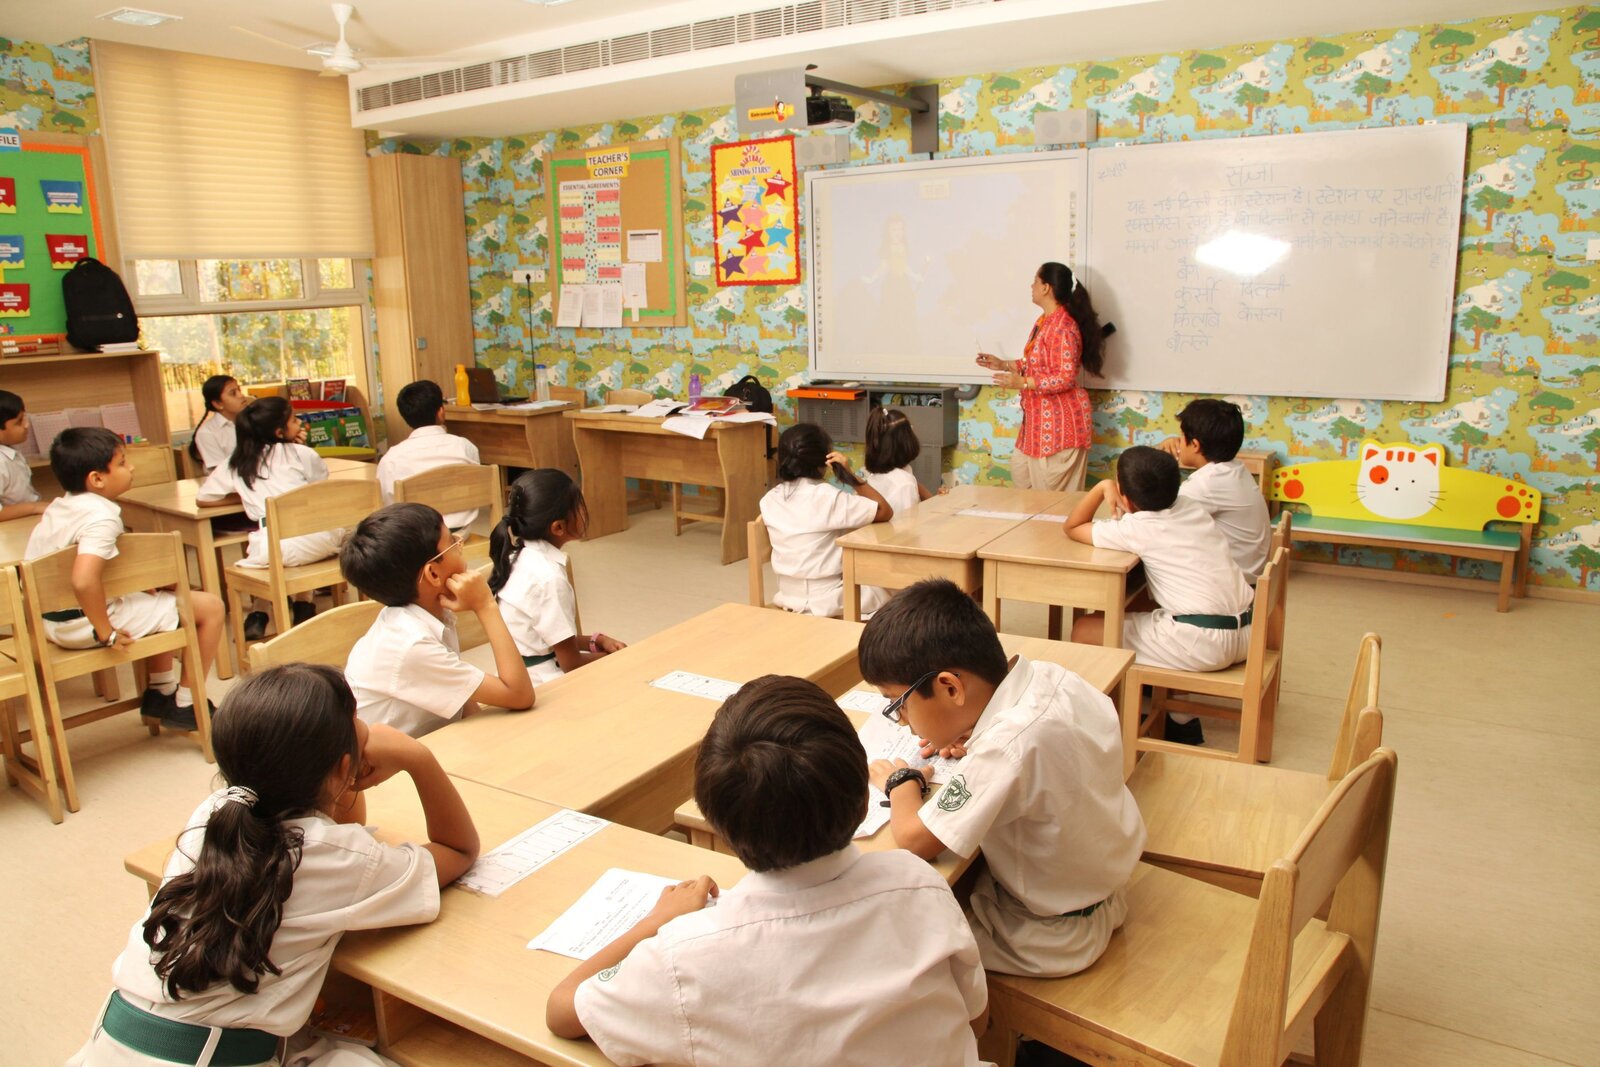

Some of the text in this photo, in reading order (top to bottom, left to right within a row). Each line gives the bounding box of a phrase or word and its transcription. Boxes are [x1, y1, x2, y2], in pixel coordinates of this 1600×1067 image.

[588, 152, 629, 166] TEACHER'S
[593, 165, 624, 177] CORNER
[562, 181, 620, 191] ESSENTIAL AGREEMENTS
